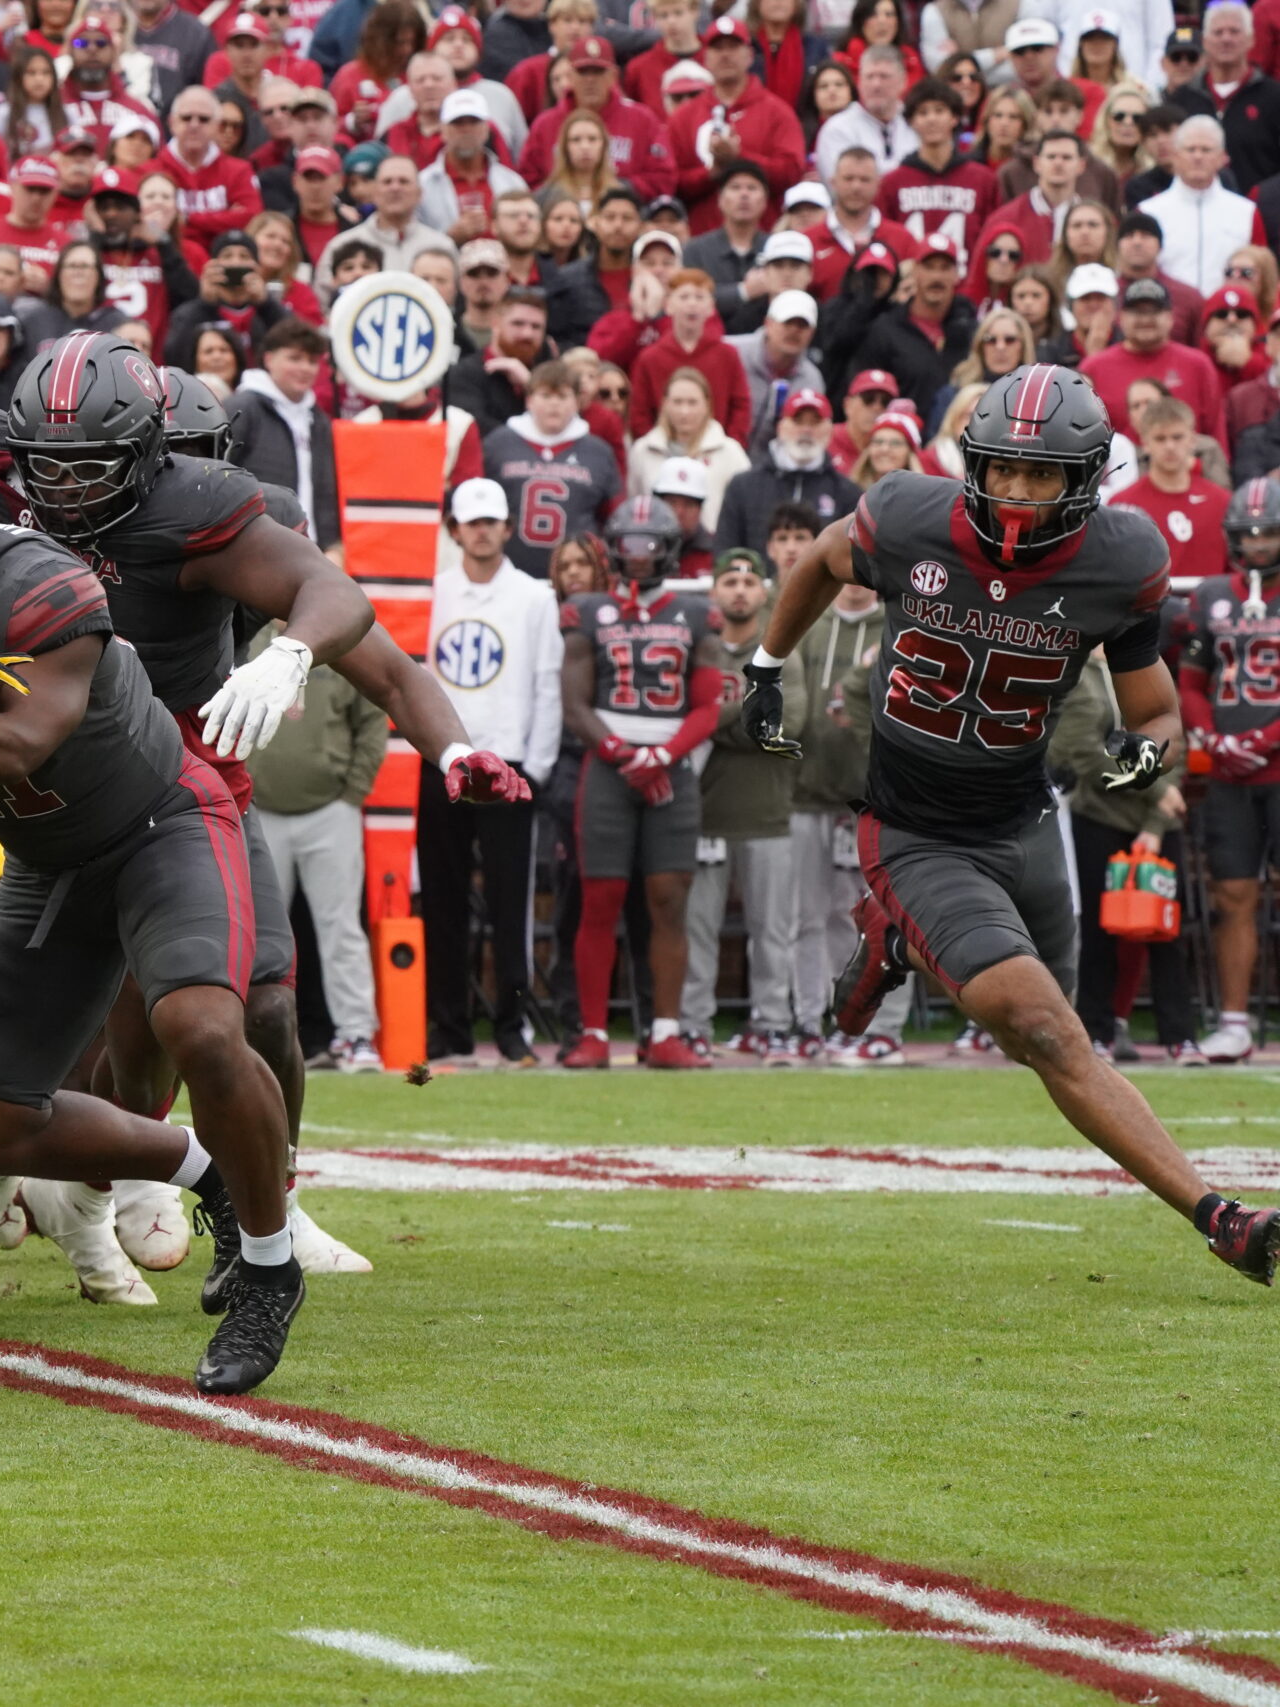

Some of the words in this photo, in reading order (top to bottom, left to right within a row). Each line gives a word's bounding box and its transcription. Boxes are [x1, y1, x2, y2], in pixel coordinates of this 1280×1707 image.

[352, 293, 435, 381] SEC
[519, 477, 570, 549] 6
[912, 561, 947, 595] SEC
[989, 580, 1007, 601] OU
[436, 619, 503, 688] SEC
[902, 593, 1080, 651] OKLAHOMA
[606, 640, 689, 712] 13
[883, 627, 1070, 749] 25
